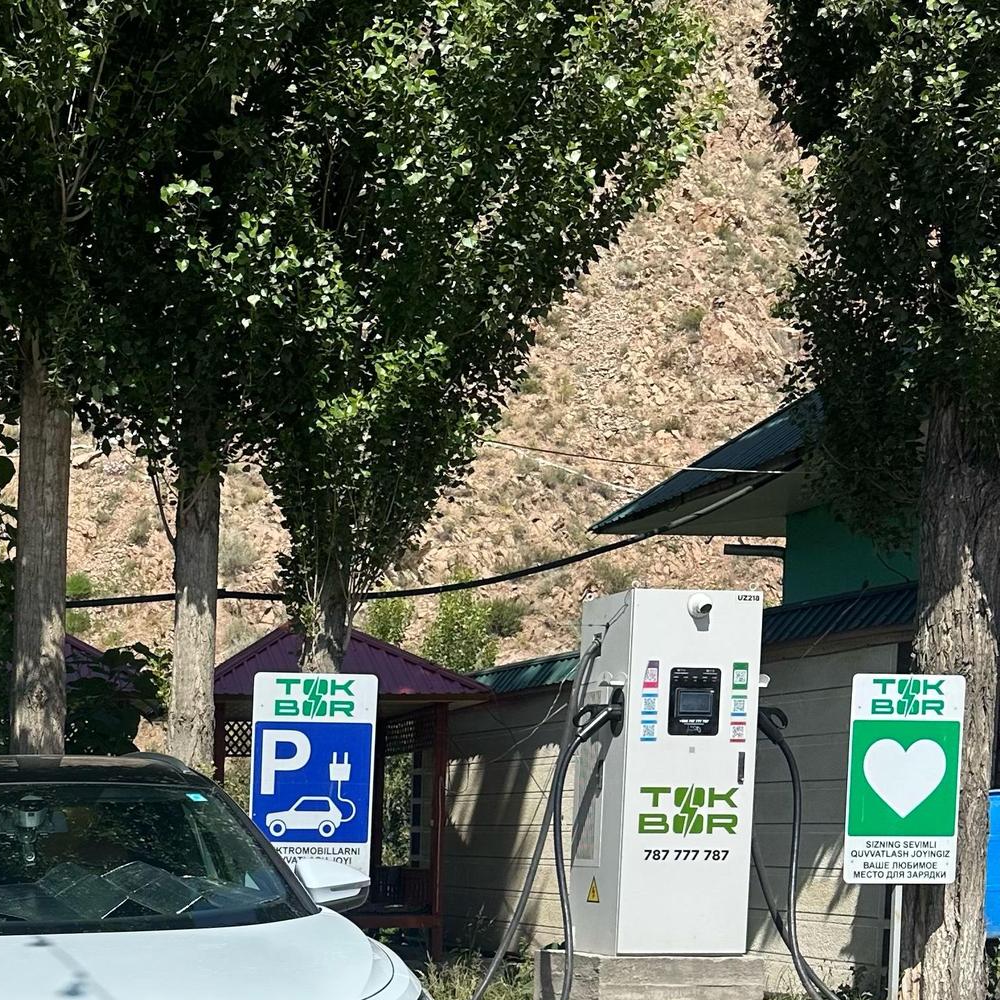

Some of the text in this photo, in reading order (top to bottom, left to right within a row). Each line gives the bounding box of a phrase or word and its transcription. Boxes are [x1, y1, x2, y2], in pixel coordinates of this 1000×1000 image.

[276, 677, 355, 697] TOK
[873, 678, 945, 695] TOK
[275, 700, 355, 718] BOR
[871, 699, 944, 716] BOR
[260, 729, 311, 795] P
[640, 785, 739, 808] TOK
[638, 813, 738, 836] BOR
[275, 846, 360, 855] KTROMOBILLARNI
[865, 841, 937, 849] SIZNING SEVIMLI
[644, 849, 730, 861] 787 777 787
[850, 850, 950, 858] QUVVATLASH JOYINGIZ
[863, 862, 938, 870] ВАШЕ ЛЮБИМОЕ
[886, 871, 905, 879] ДЛЯ
[907, 871, 947, 879] ЗАРЯДКИ
